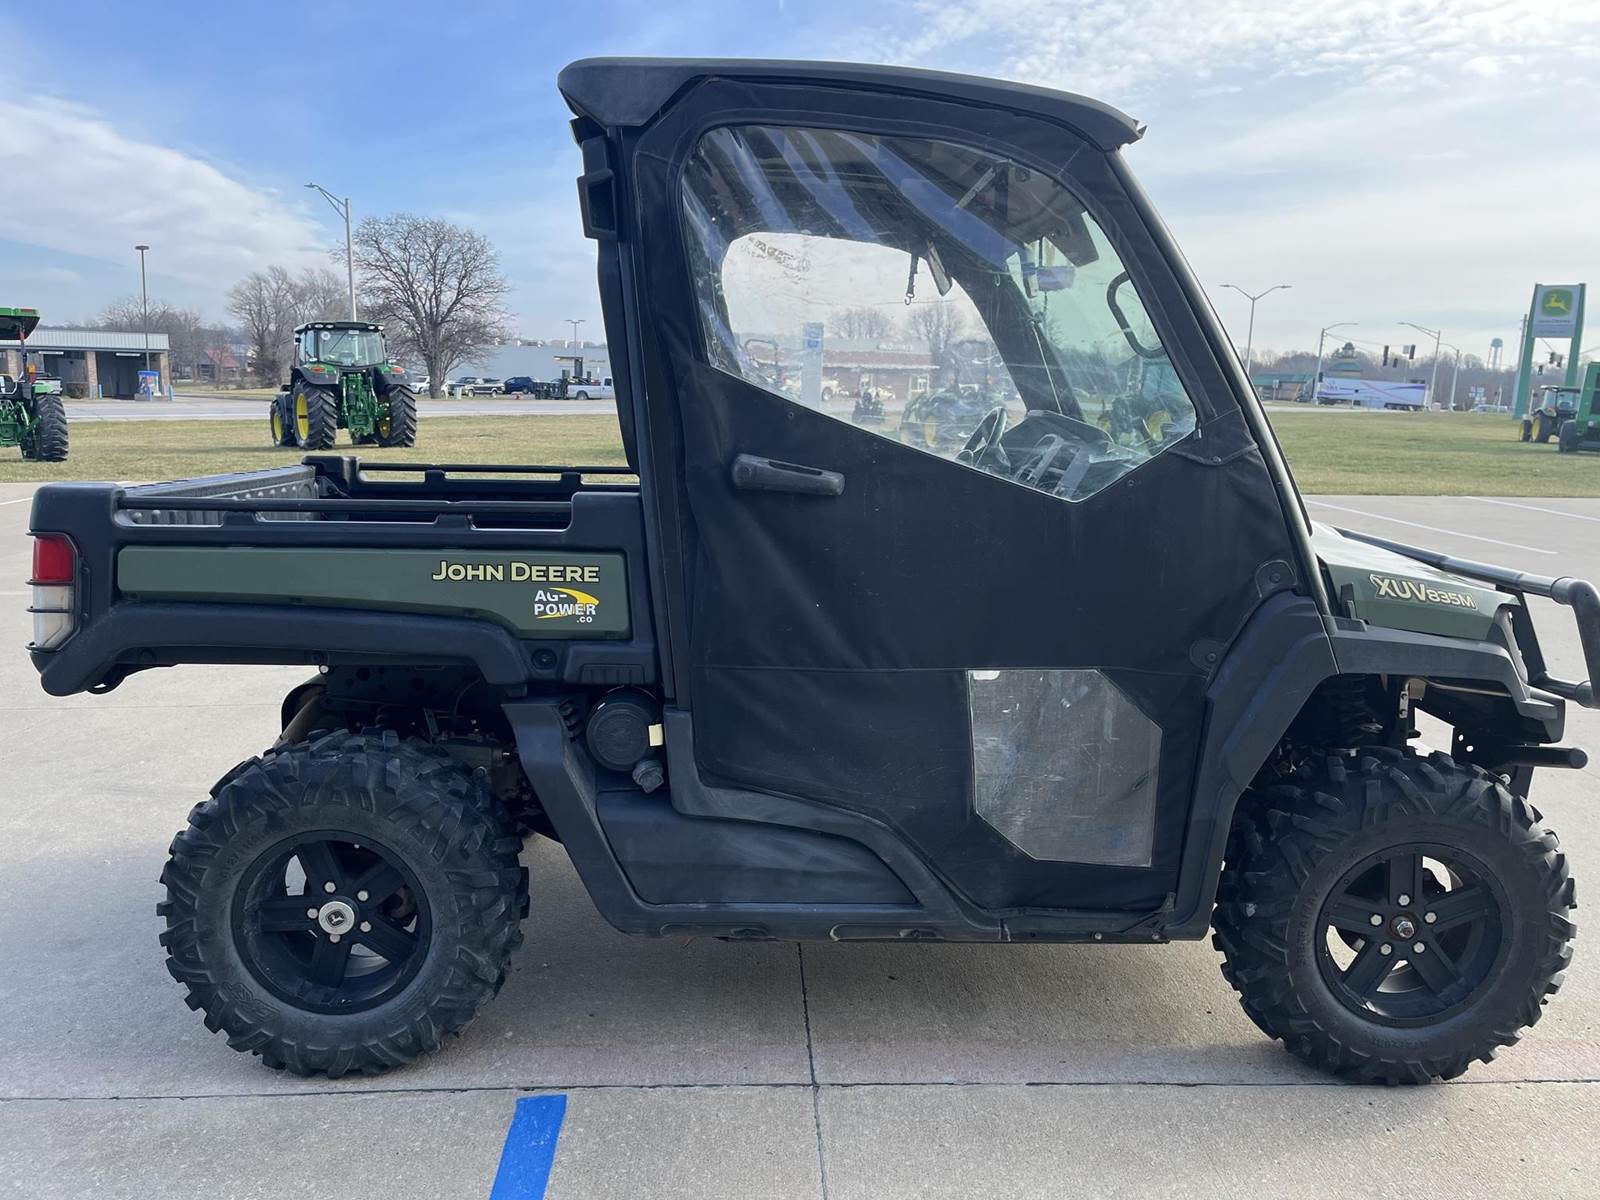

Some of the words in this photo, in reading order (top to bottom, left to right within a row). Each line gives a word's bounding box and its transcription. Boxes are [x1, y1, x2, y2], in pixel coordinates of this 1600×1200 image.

[432, 560, 504, 581] JOHN
[510, 561, 600, 583] DEERE
[534, 603, 597, 616] POWER
